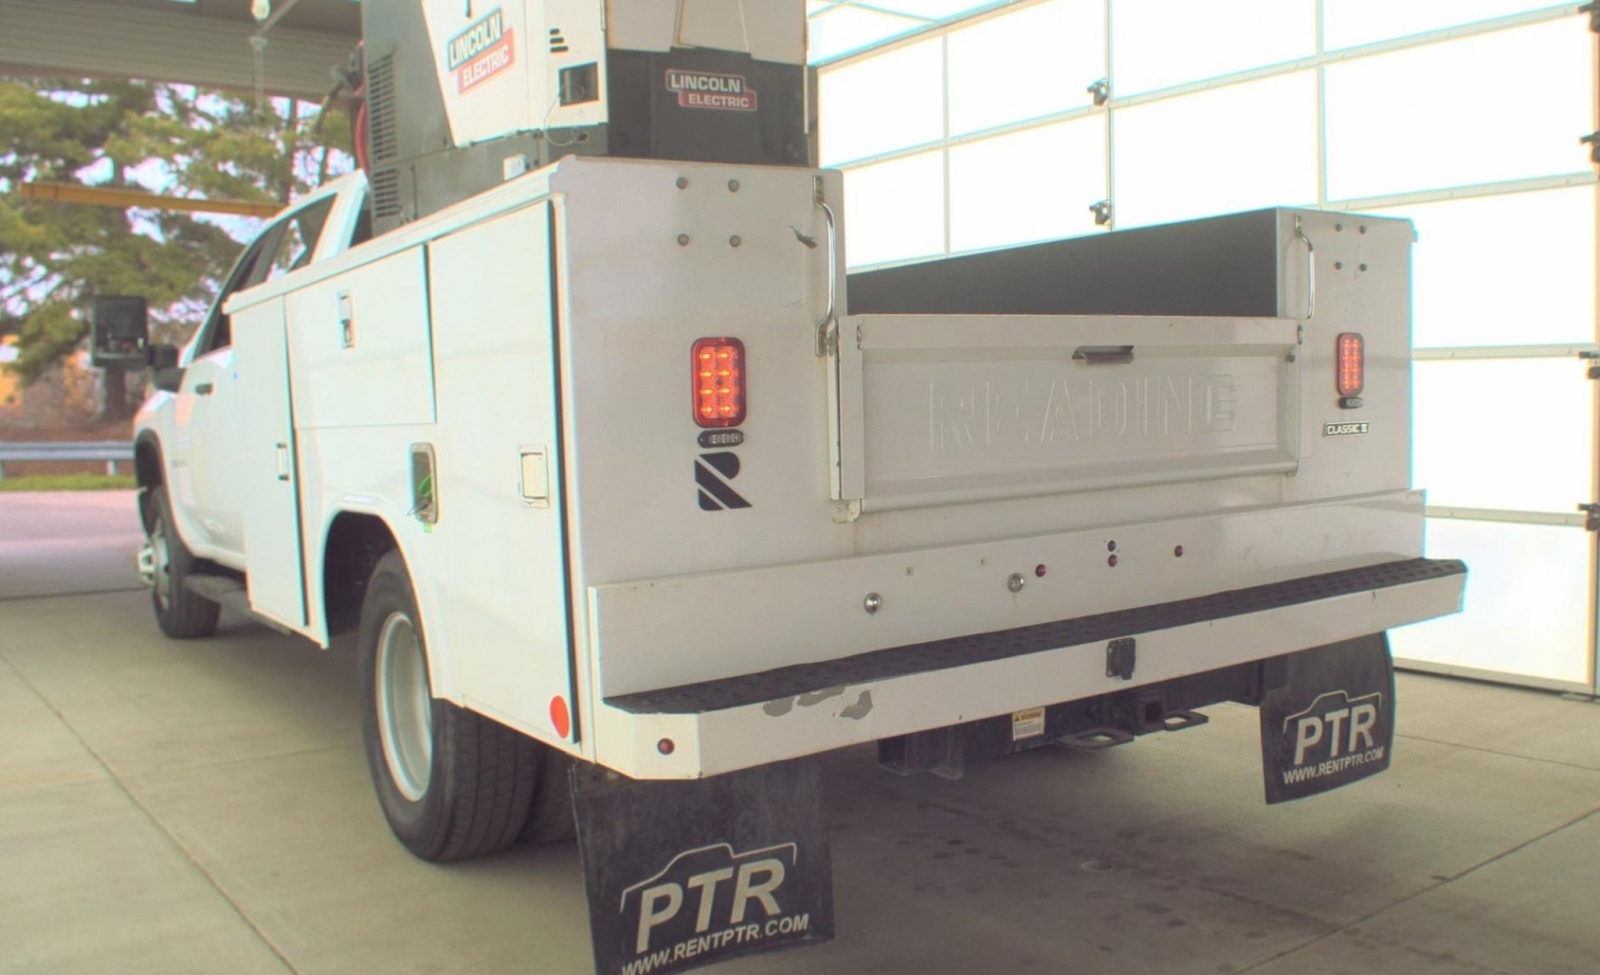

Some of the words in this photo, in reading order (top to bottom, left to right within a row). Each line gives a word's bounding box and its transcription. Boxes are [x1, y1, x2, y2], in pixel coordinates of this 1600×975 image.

[449, 11, 502, 69] LINCOLN
[463, 45, 510, 88] ELECTRIC
[671, 74, 741, 93] LINCOLN
[688, 93, 749, 108] ELECTRIC
[929, 374, 1238, 449] READING
[1327, 424, 1360, 435] CLASSIC
[1294, 703, 1377, 766] PTR
[1283, 746, 1384, 785] WWW.RENTPTR.COM
[636, 858, 786, 955] PTR
[621, 913, 809, 975] WWW.RENTPTR.COM
